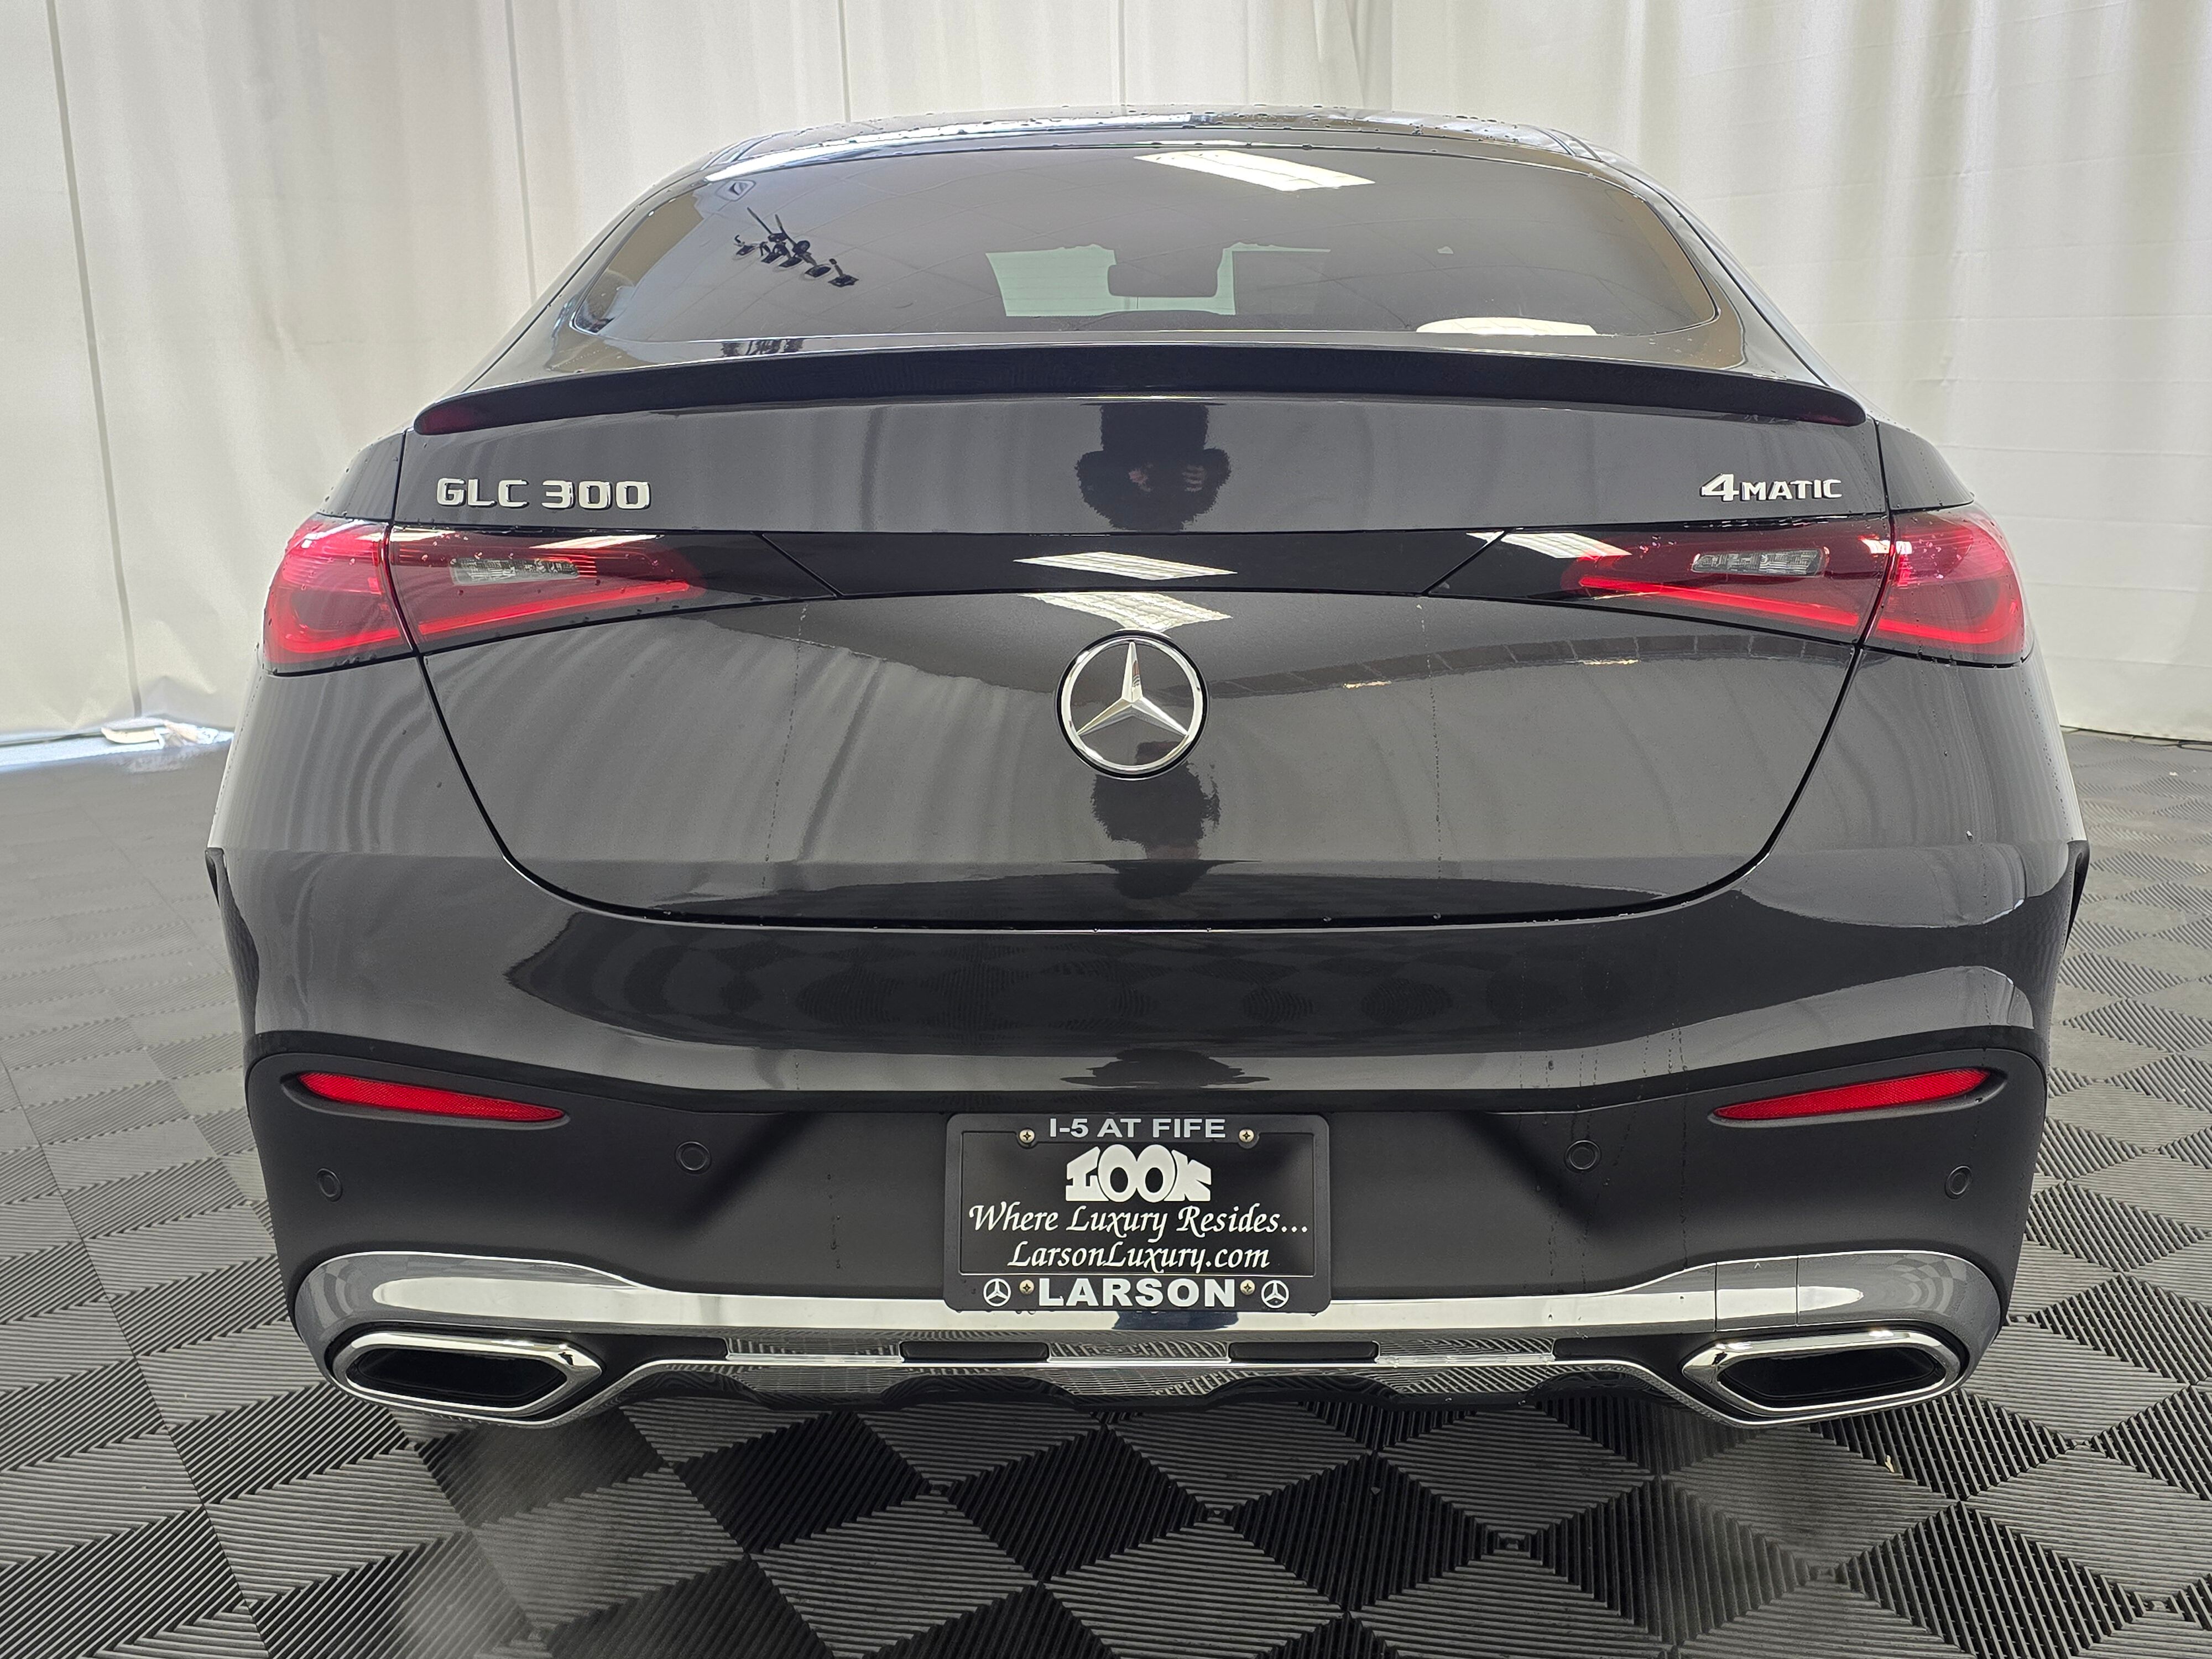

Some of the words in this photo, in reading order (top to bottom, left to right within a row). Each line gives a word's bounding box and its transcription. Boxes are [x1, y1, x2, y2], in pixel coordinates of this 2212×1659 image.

[437, 478, 529, 508] GLC
[541, 480, 650, 509] 300
[1700, 473, 1843, 501] 4MATIC
[1051, 1119, 1088, 1138] I-5
[1097, 1119, 1141, 1138] AT
[1153, 1119, 1225, 1138] FIFE
[969, 1202, 1058, 1231] Where
[1066, 1206, 1167, 1242] Luxury
[1176, 1203, 1308, 1237] Resides...
[1008, 1241, 1270, 1273] LarsonLuxury.com
[1038, 1279, 1235, 1307] LARSON
